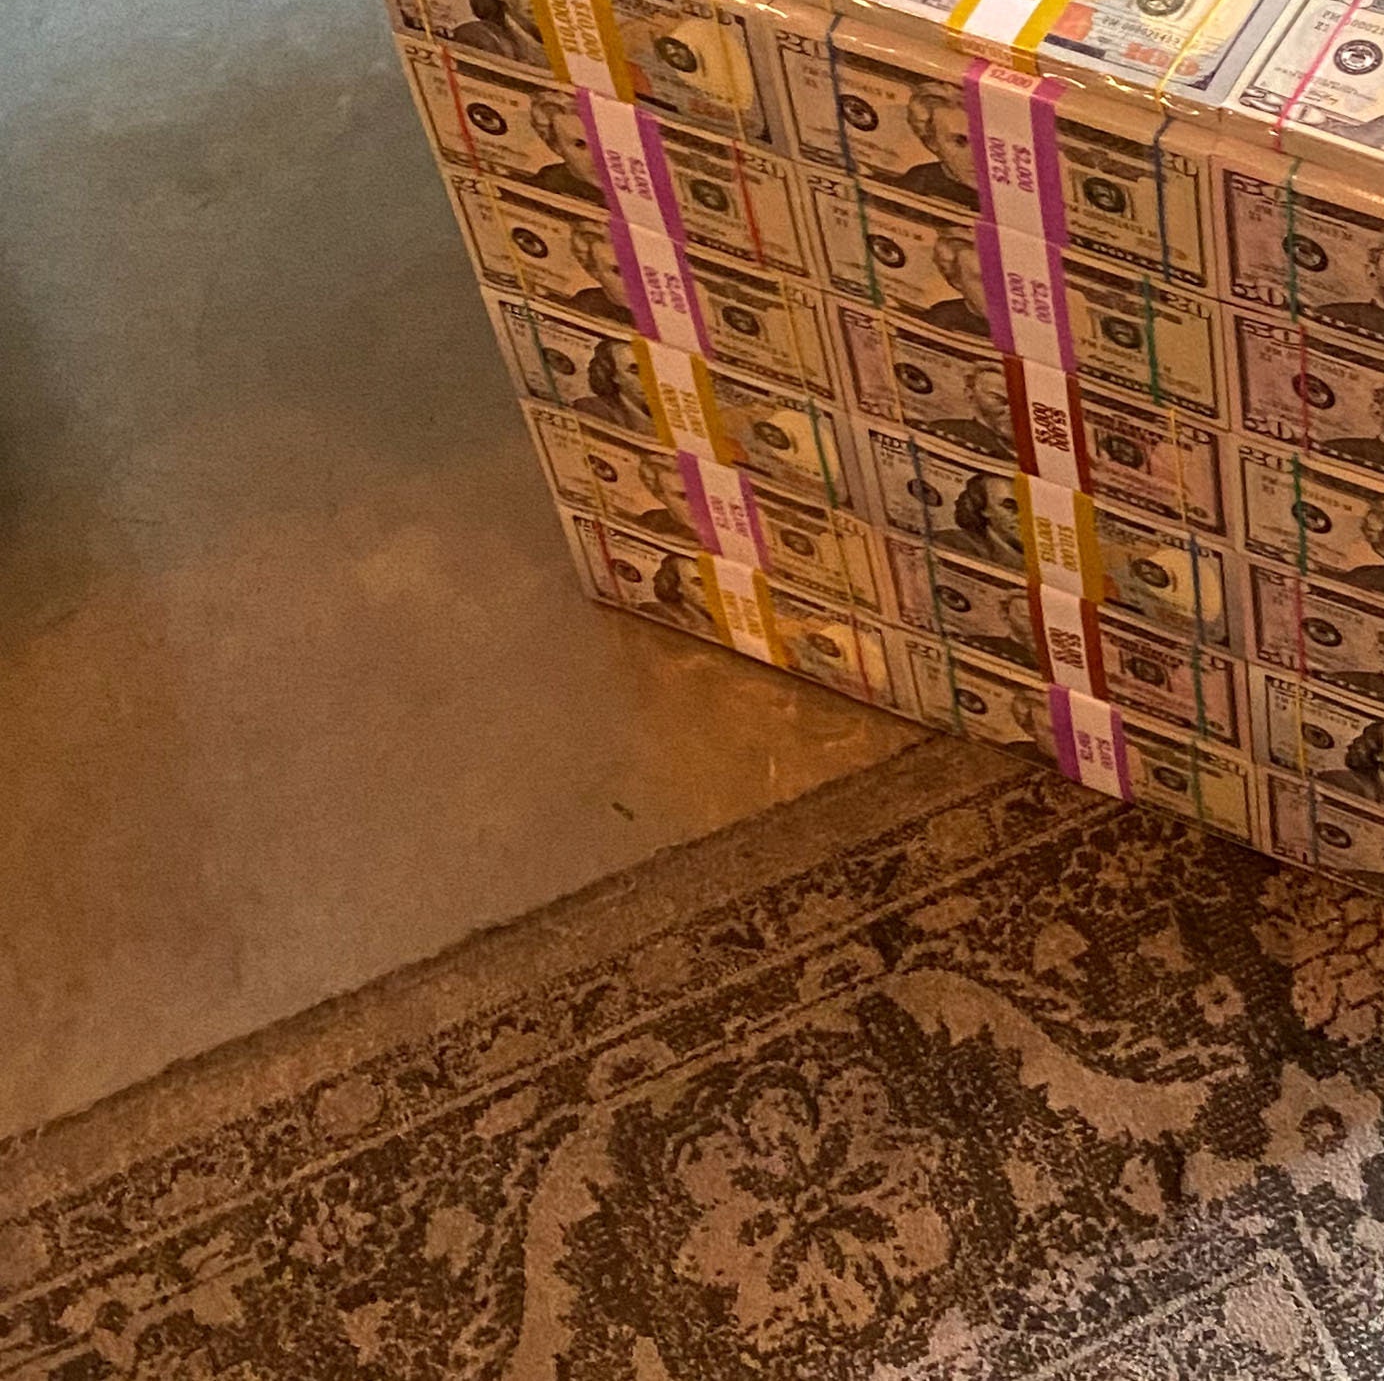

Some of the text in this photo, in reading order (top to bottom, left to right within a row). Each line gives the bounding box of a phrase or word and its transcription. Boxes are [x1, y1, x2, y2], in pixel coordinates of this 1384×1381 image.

[987, 136, 1010, 185] $2,000
[1012, 145, 1035, 194] $2,000
[1007, 271, 1028, 316] $2,000
[1030, 279, 1051, 324] $2,000
